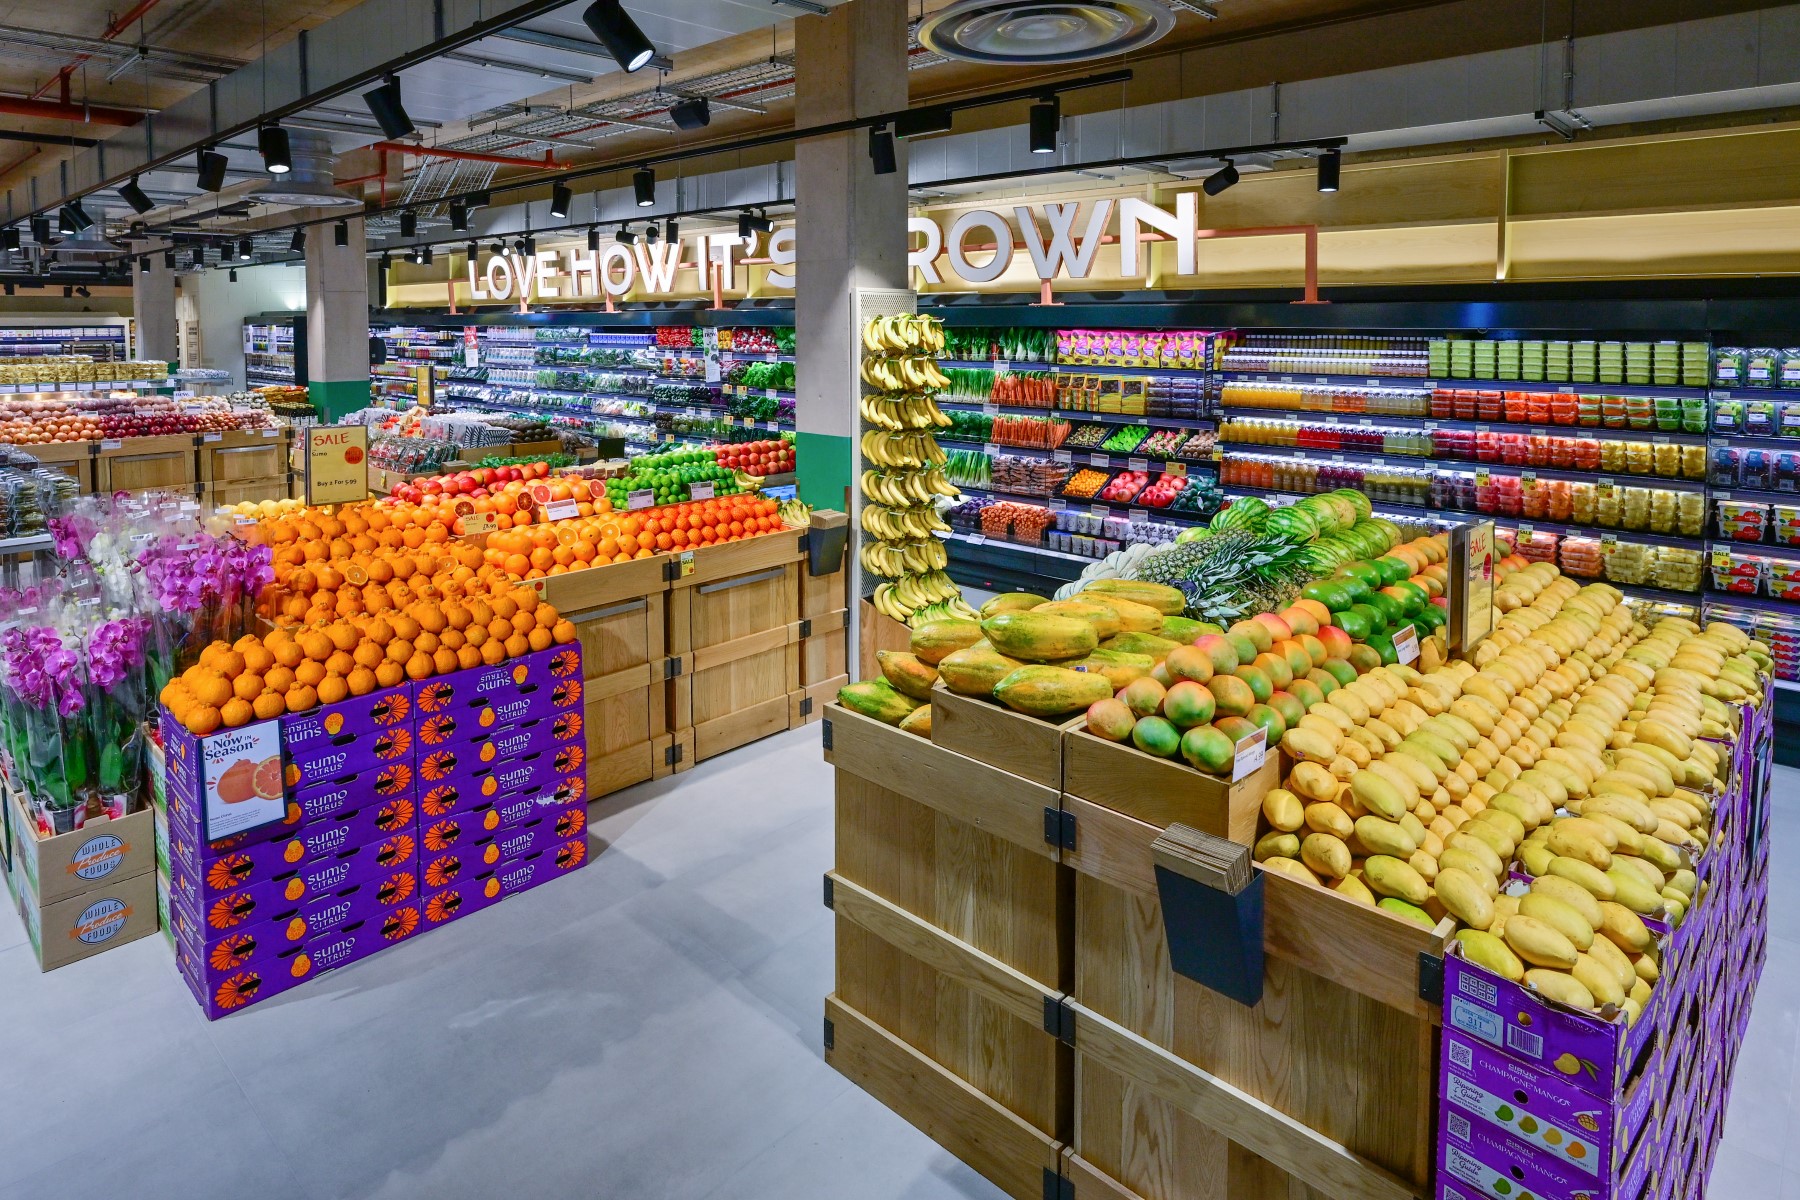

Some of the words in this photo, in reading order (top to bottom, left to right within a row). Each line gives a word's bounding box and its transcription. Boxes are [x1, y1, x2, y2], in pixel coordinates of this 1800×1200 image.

[468, 249, 560, 300] LOVE
[570, 239, 684, 297] HOW
[908, 192, 1198, 284] ROWN
[313, 432, 350, 446] SALE
[1470, 532, 1486, 557] SALE
[500, 708, 528, 721] CITRUS
[205, 740, 254, 761] Season
[214, 736, 243, 750] Now
[500, 742, 528, 755] CITRUS
[308, 762, 344, 778] CITRUS
[502, 776, 531, 790] CITRUS
[308, 800, 346, 816] CITRUS
[504, 808, 531, 824] CITRUS
[81, 838, 116, 856] WHOLE
[310, 835, 346, 854] CITRUS
[504, 841, 532, 856] CITRUS
[78, 850, 121, 870] Produce
[84, 860, 116, 877] FOODS
[311, 873, 348, 891] CITRUS
[505, 874, 532, 890] CITRUS
[84, 902, 119, 919] WHOLE
[80, 914, 123, 934] Produce
[312, 911, 348, 930] CITRUS
[87, 924, 118, 942] FOODS
[317, 947, 353, 967] CITRUS
[1480, 1060, 1531, 1090] CHAMPAGNE
[1453, 1076, 1484, 1098] Ripening
[1460, 1089, 1481, 1104] Guide
[1477, 1133, 1529, 1166] CHAMPAGNE
[1452, 1148, 1482, 1170] Ripening
[1459, 1161, 1479, 1176] Guide
